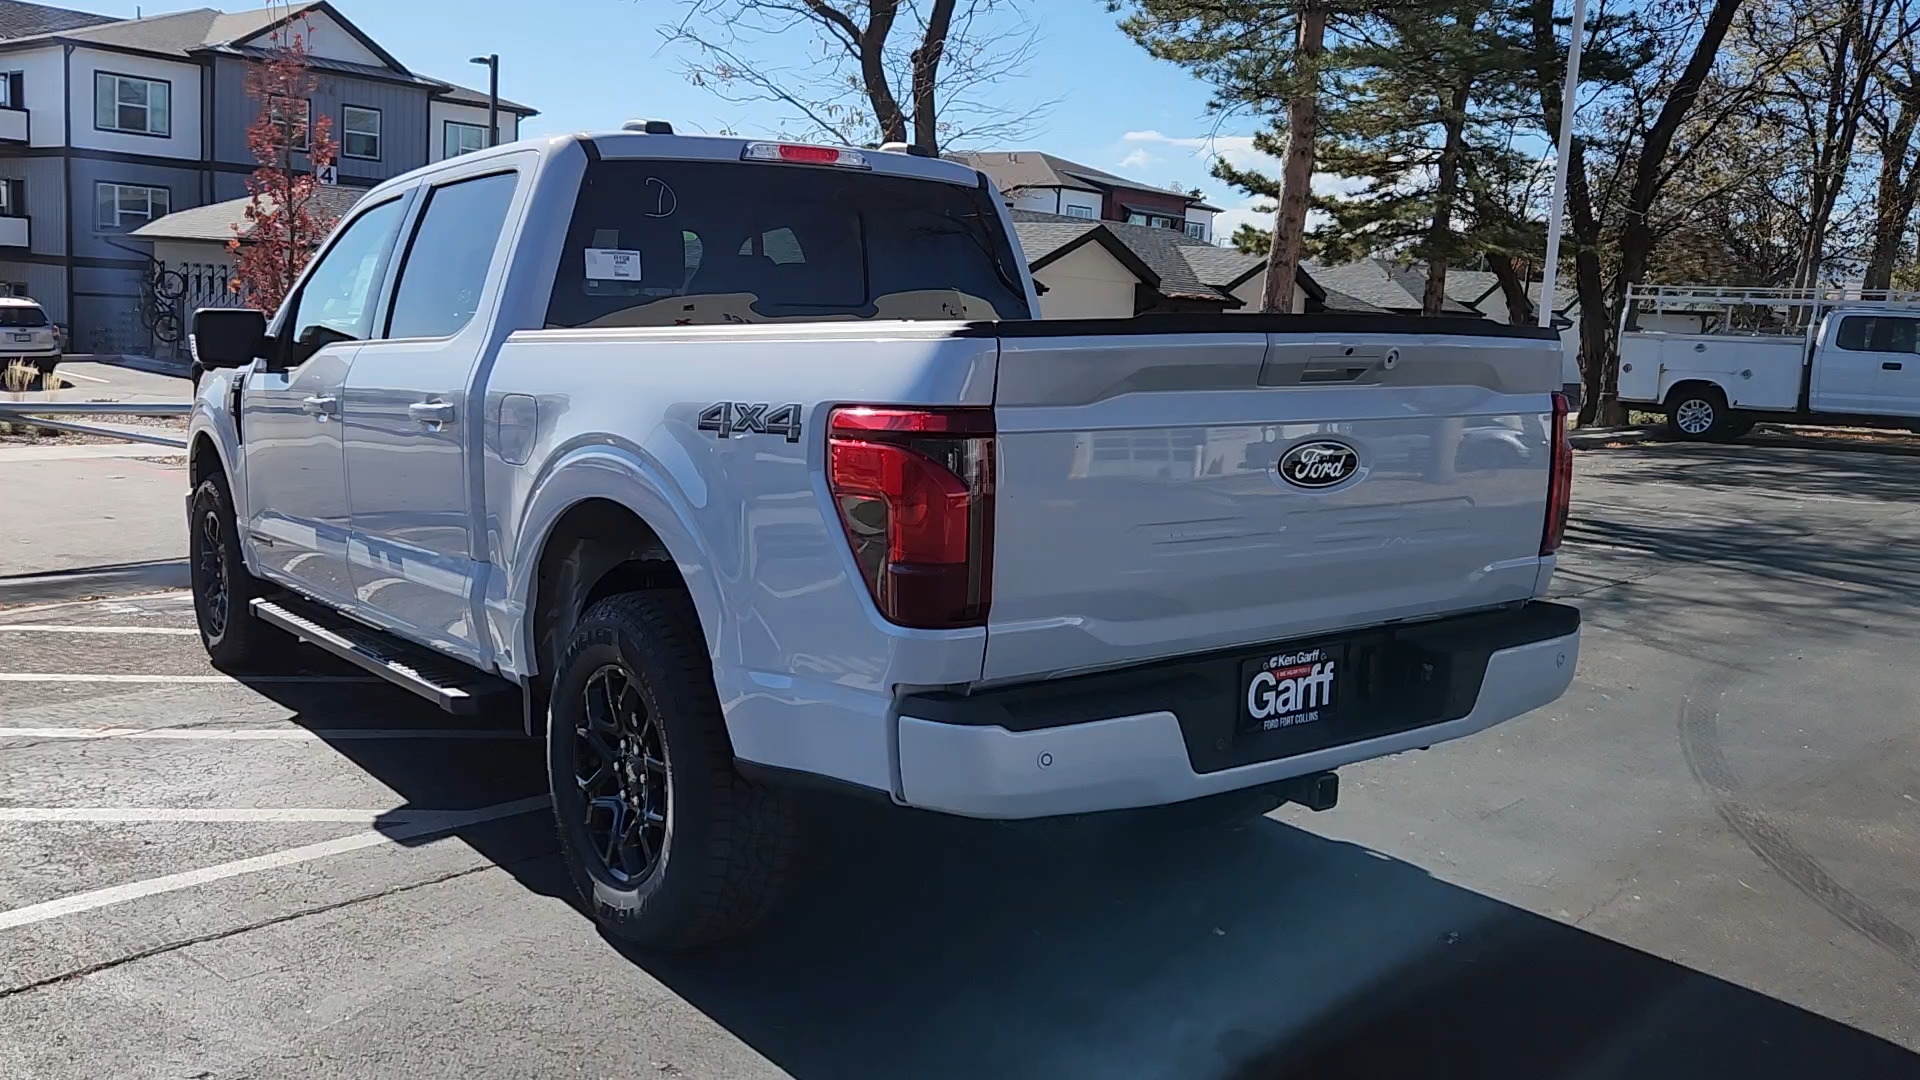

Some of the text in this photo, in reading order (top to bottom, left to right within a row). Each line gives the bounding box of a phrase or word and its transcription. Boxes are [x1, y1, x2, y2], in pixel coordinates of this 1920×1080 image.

[320, 167, 333, 184] 4
[645, 177, 677, 218] D
[1294, 448, 1346, 480] Ford
[1278, 649, 1320, 667] Ken Garff
[1248, 661, 1335, 719] Garff
[1263, 711, 1319, 731] FORD FORT COLLINS
